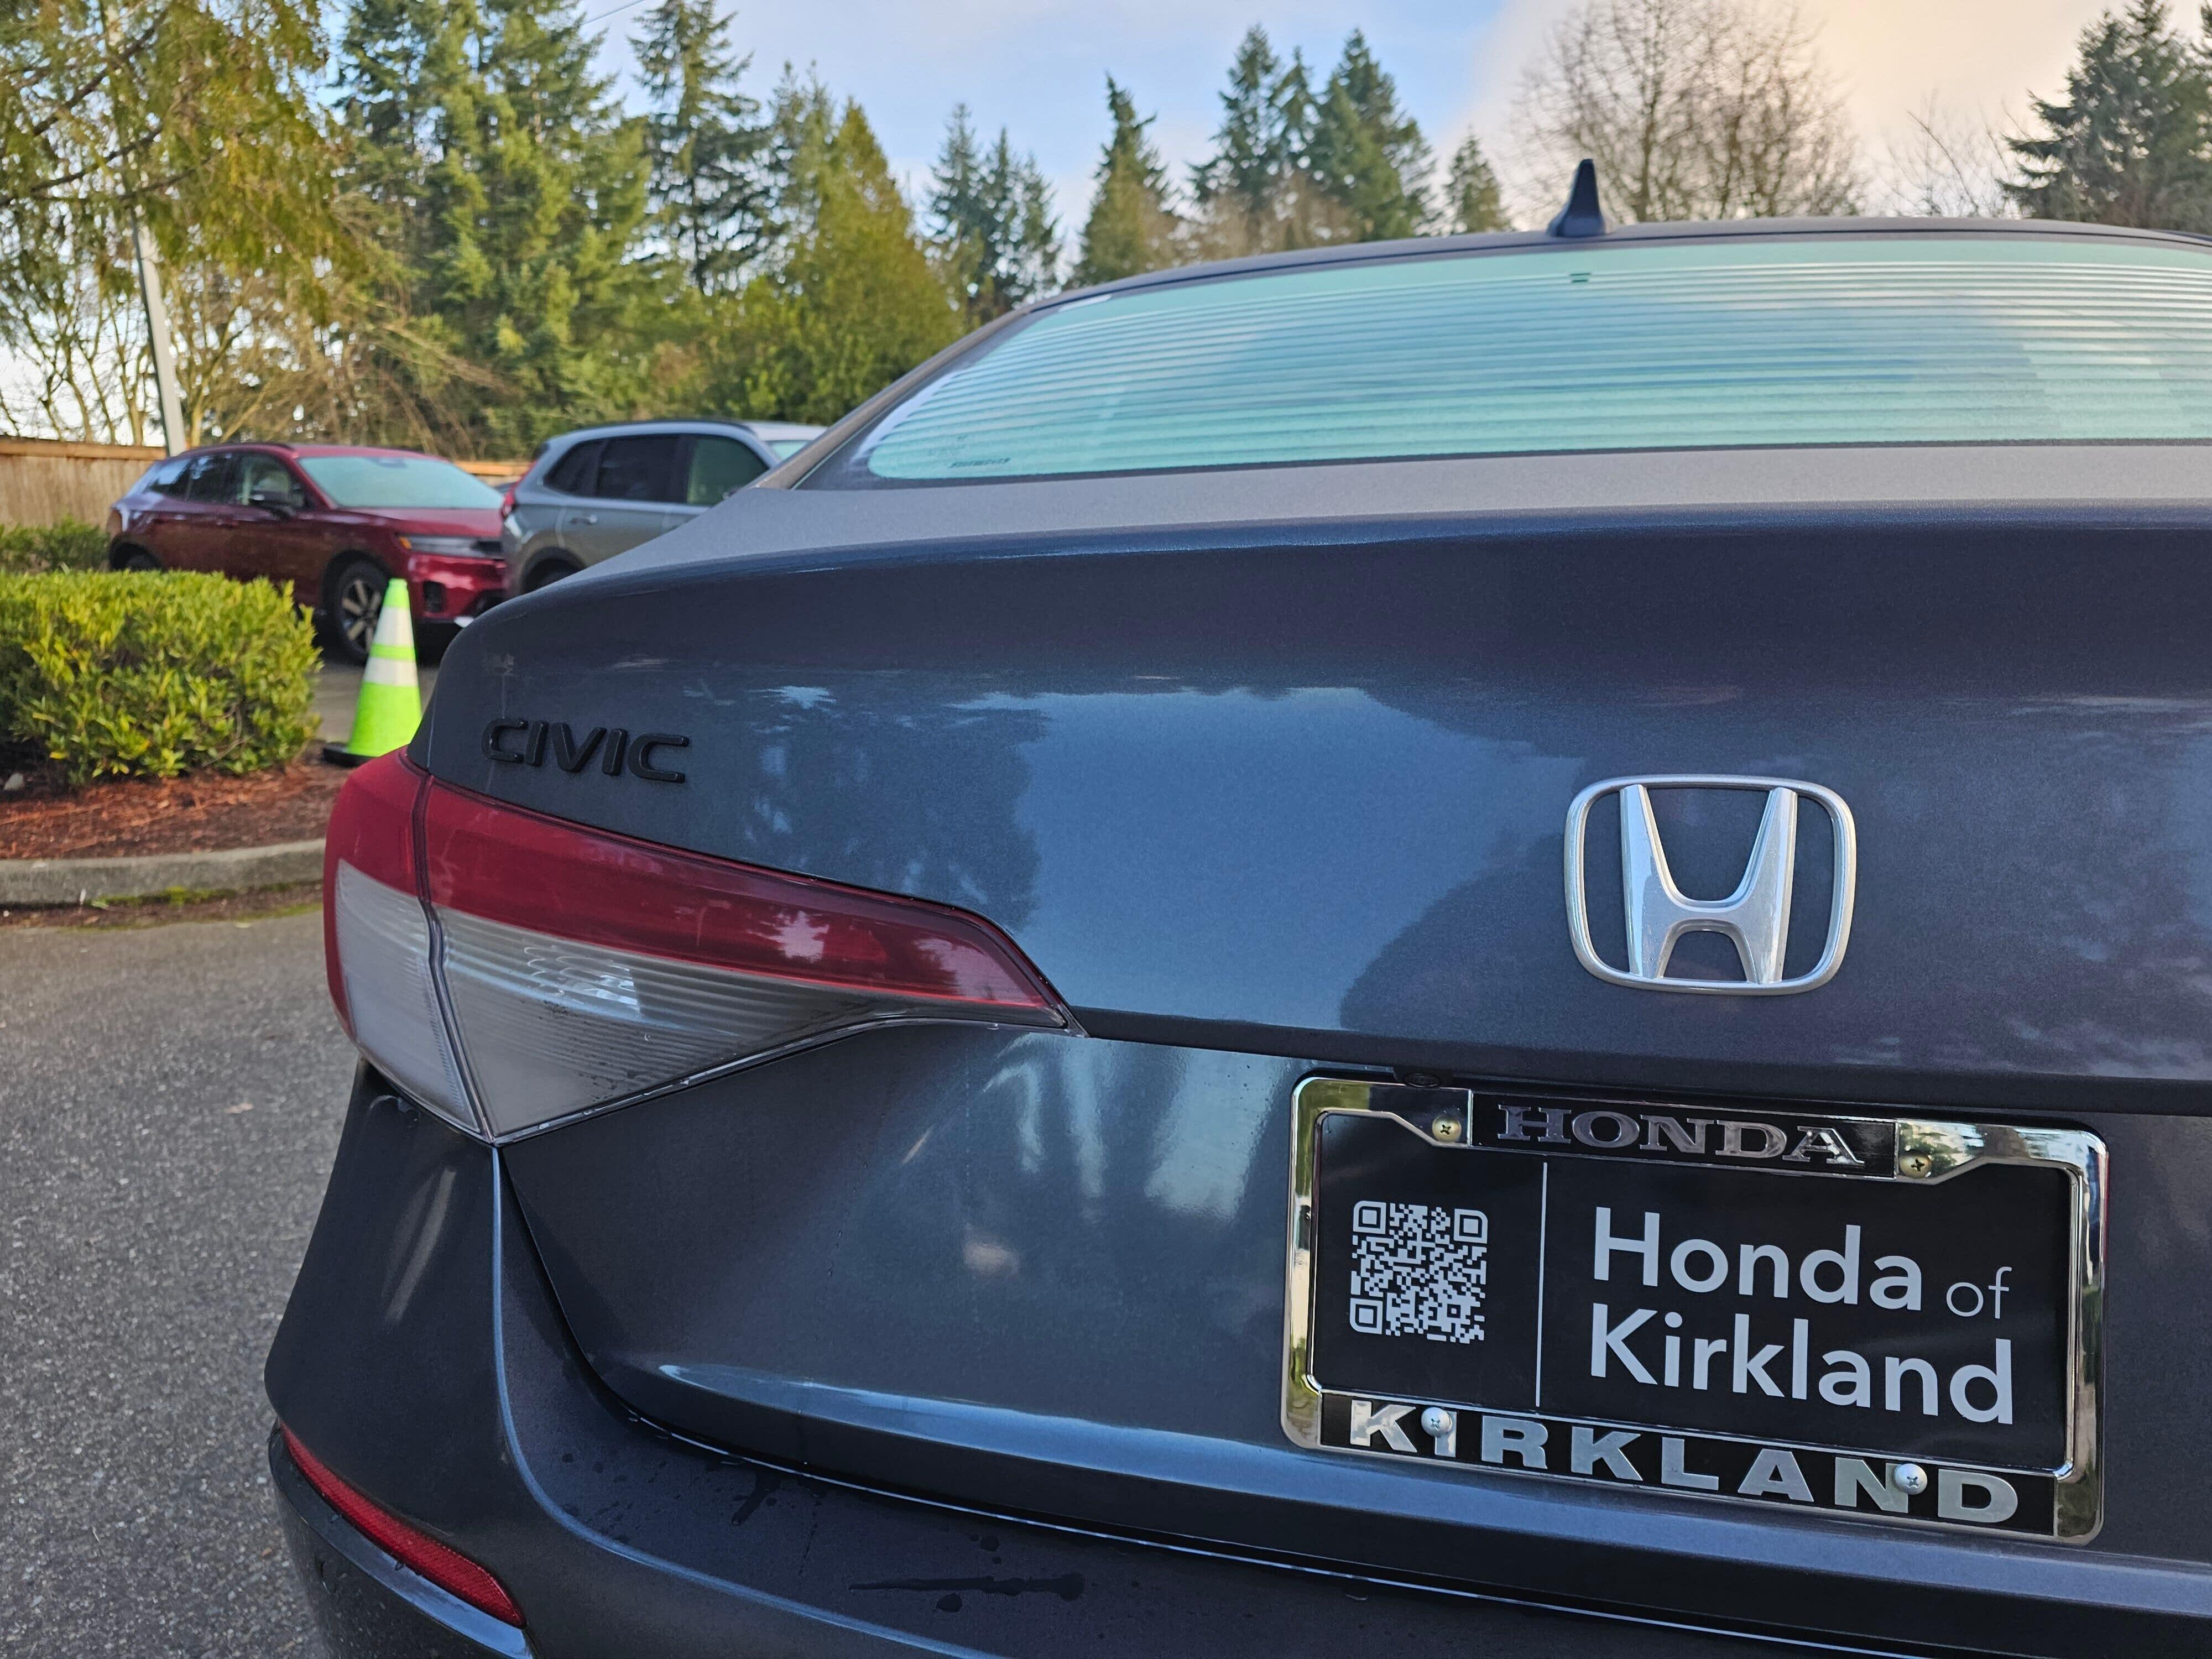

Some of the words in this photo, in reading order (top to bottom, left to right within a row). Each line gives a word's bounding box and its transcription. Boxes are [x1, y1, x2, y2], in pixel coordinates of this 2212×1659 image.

[482, 719, 690, 784] CIVIC
[1498, 1105, 1865, 1165] HONDA
[1594, 1207, 1922, 1311] Honda
[1946, 1266, 2012, 1319] of
[1591, 1303, 2013, 1425] Kirkland
[1350, 1400, 2018, 1522] KIRKLAND
